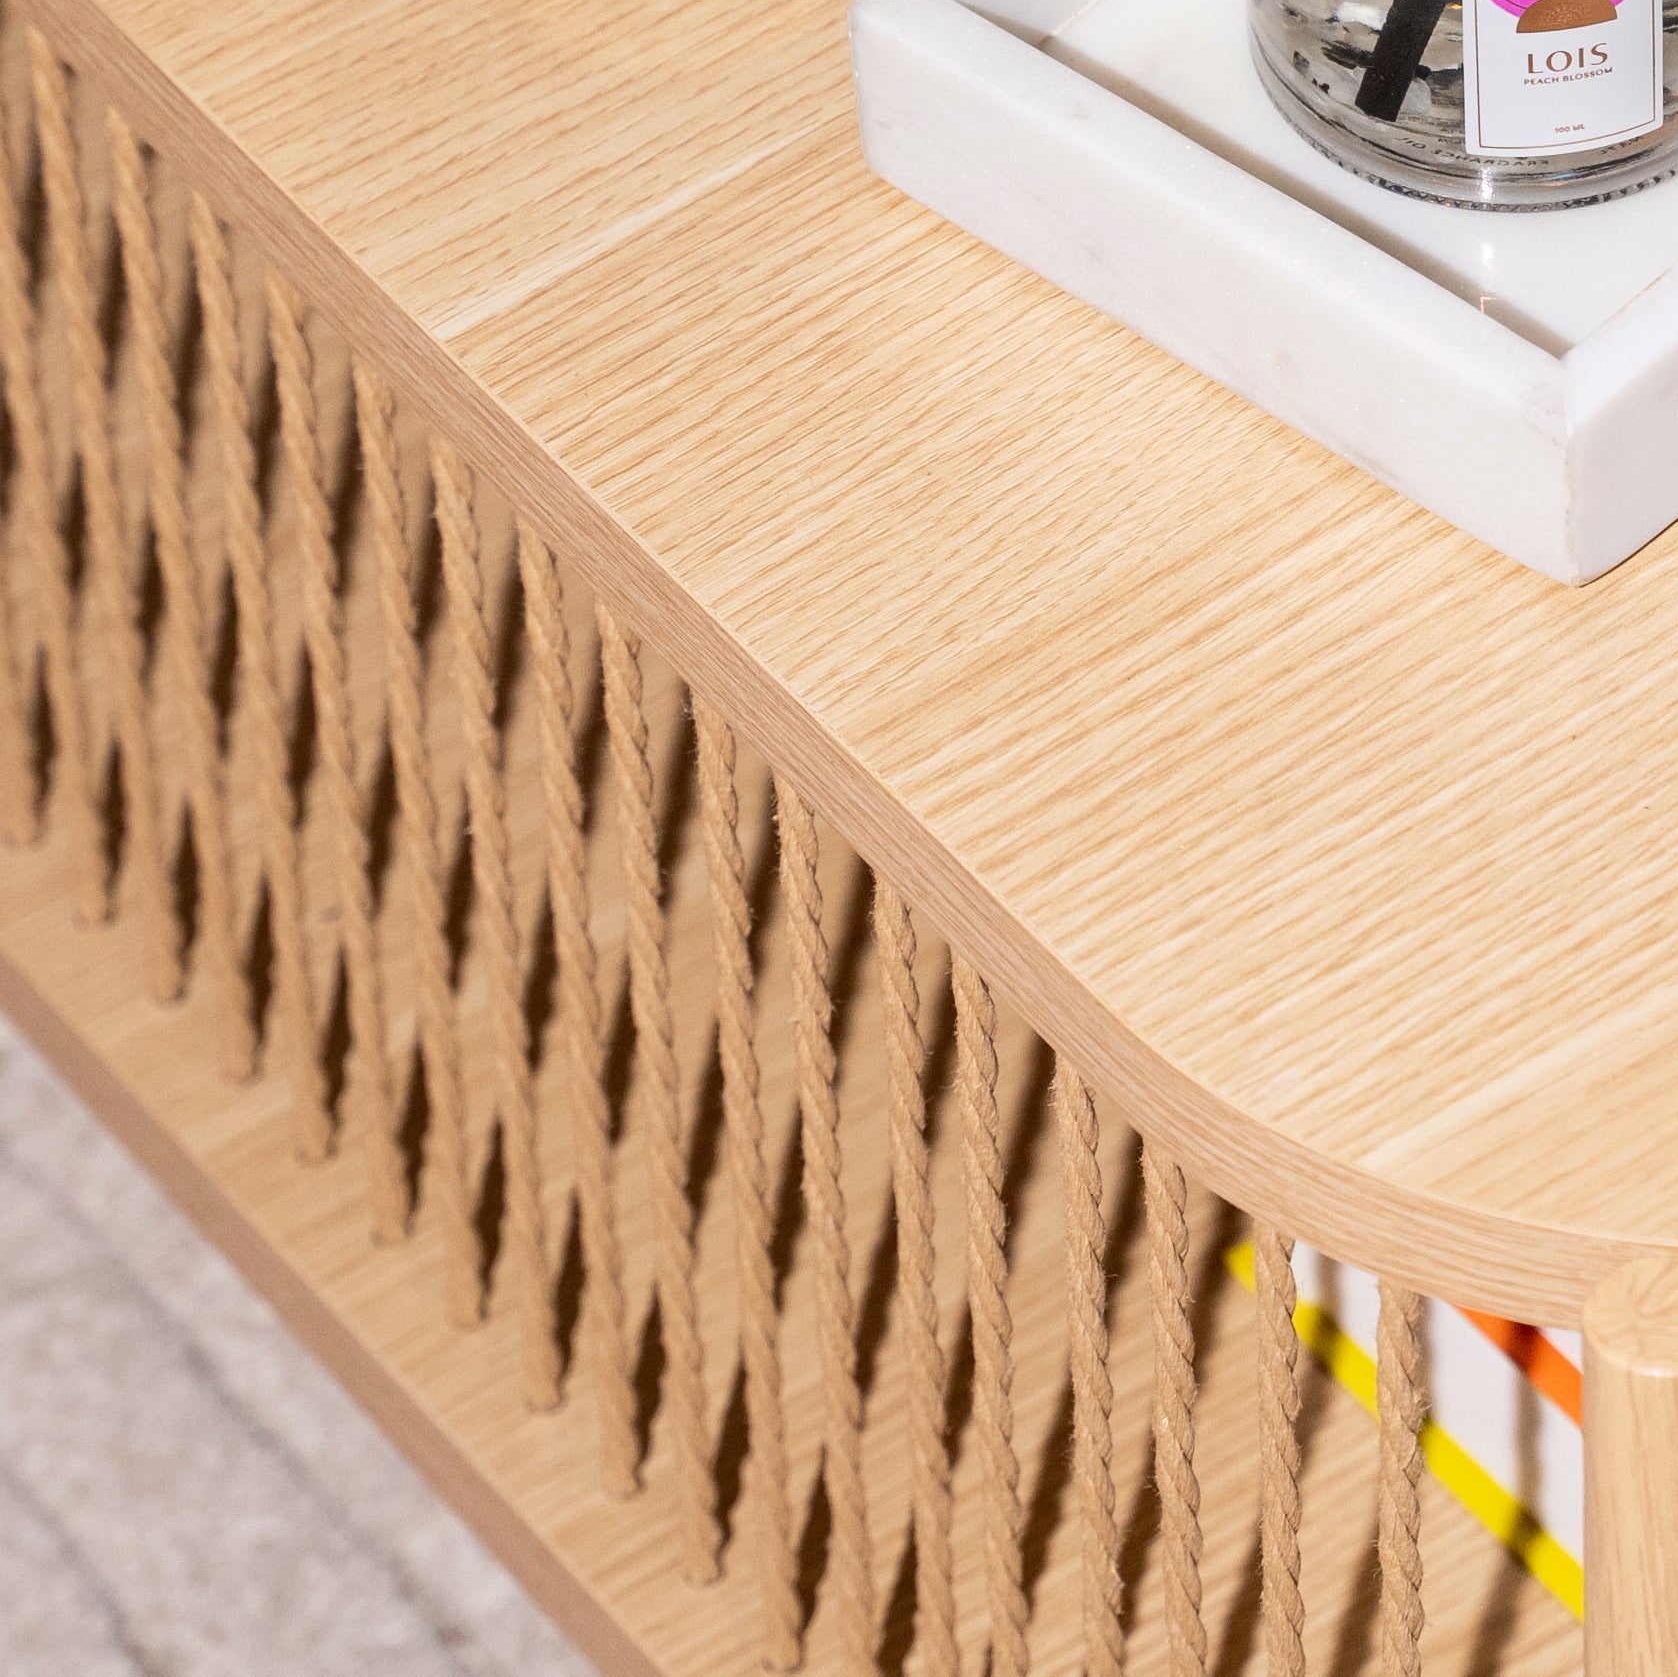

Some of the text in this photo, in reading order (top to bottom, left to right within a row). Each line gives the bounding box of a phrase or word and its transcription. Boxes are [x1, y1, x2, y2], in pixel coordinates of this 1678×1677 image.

[1527, 42, 1608, 74] LOIS
[1523, 66, 1613, 86] PEACH BLOSSOM
[1554, 125, 1571, 134] 100
